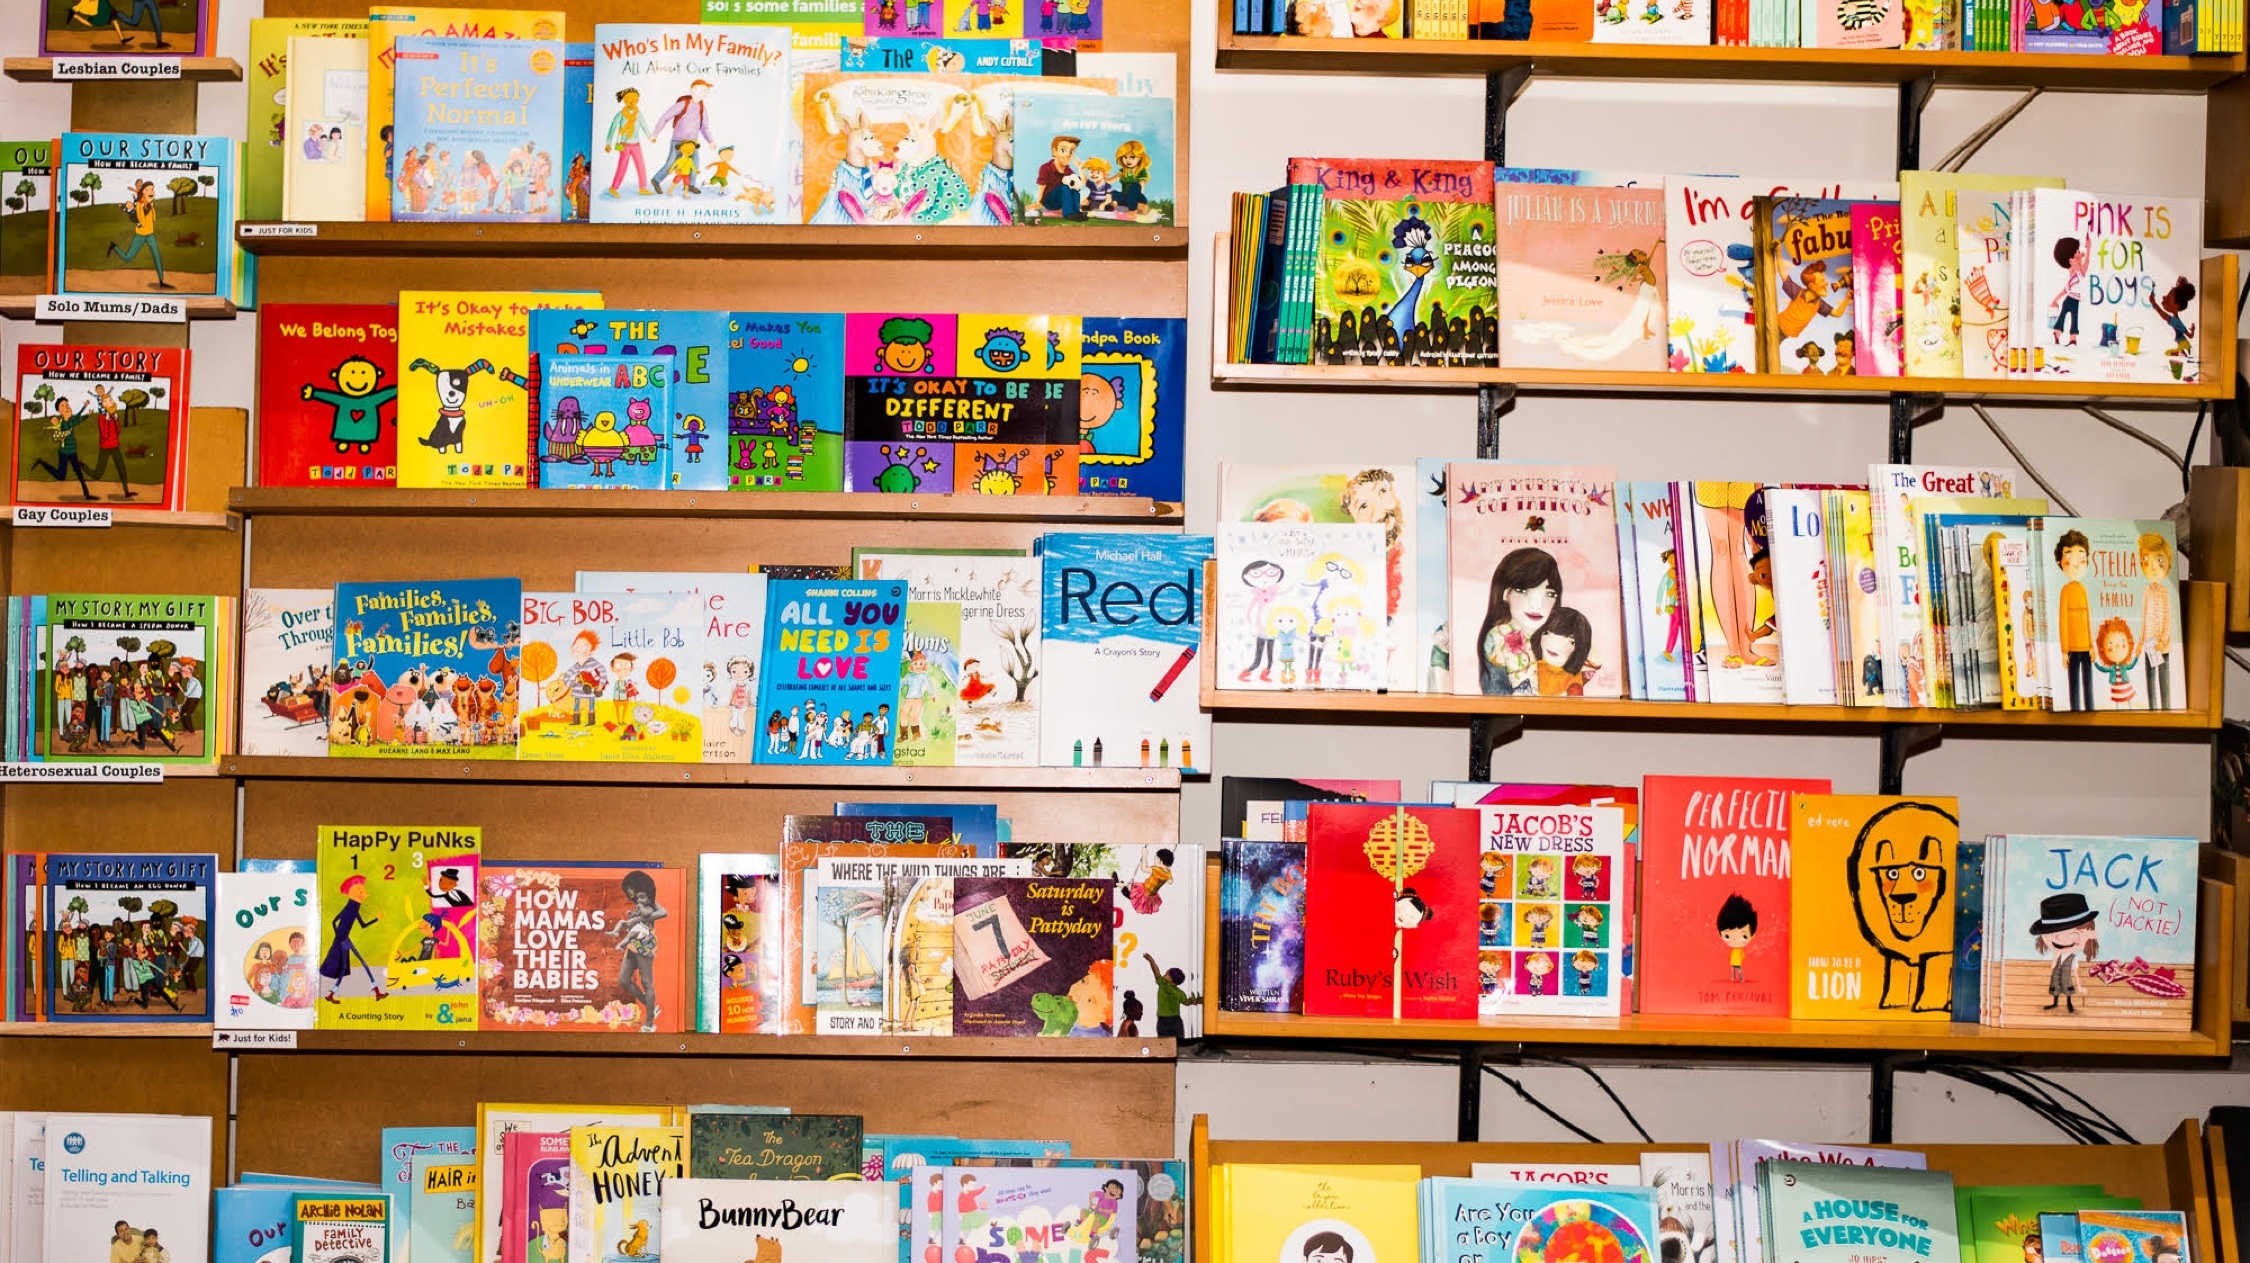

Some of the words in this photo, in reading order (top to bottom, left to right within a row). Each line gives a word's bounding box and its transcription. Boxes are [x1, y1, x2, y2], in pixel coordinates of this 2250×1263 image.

[603, 38, 658, 61] Who's
[663, 34, 680, 50] In
[686, 34, 716, 56] My
[718, 35, 782, 67] Family?
[882, 48, 914, 69] The
[58, 62, 117, 75] Lesbian
[121, 63, 180, 76] Couples
[459, 51, 497, 74] It's
[646, 60, 682, 75] About
[686, 62, 712, 75] Our
[716, 62, 762, 77] Families
[976, 56, 999, 67] ANDY
[420, 77, 538, 104] Perfectly
[426, 103, 528, 126] Normal
[80, 140, 130, 159] OUR
[142, 141, 209, 159] STORY
[1314, 167, 1376, 196] King
[1405, 169, 1473, 198] King
[694, 209, 739, 218] HARRIS
[1685, 187, 1729, 226] I'm
[257, 227, 277, 235] JUST
[278, 227, 294, 235] FOR
[296, 227, 314, 235] KIDS
[1452, 261, 1497, 274] AMONG
[47, 300, 80, 314] Solo
[84, 301, 179, 316] Mums/Dads
[414, 301, 450, 316] It's
[456, 301, 501, 319] Okay
[508, 302, 529, 316] to
[280, 323, 306, 338] We
[312, 323, 366, 342] Belong
[444, 321, 527, 337] Mistakes
[608, 321, 660, 341] THE
[745, 321, 791, 334] Makes
[796, 321, 822, 334] You
[1123, 330, 1161, 344] Book
[749, 338, 783, 350] Good
[35, 350, 84, 370] OUR
[96, 351, 162, 371] STORY
[549, 362, 597, 375] Animals
[600, 362, 611, 374] in
[549, 375, 612, 388] UNDERWEAR
[614, 363, 666, 389] ABC
[867, 378, 907, 395] IT'S
[913, 380, 967, 395] OKAY
[973, 381, 996, 396] TO
[1005, 383, 1030, 400] BE
[885, 398, 1015, 422] DIFFERENT
[952, 421, 999, 435] PARR
[1090, 477, 1128, 489] PARR
[1891, 471, 1916, 487] The
[1922, 473, 1975, 494] Great
[18, 509, 46, 523] Gay
[50, 509, 109, 522] Couples
[1096, 550, 1138, 561] Michael
[1141, 550, 1163, 561] Hall
[2091, 551, 2137, 578] STELLA
[356, 589, 446, 615] Families,
[841, 588, 878, 597] COLLINS
[908, 586, 942, 601] Morris
[944, 587, 1002, 602] Micklewhite
[1061, 567, 1196, 626] Red
[56, 600, 78, 616] MY
[81, 601, 134, 619] STORY,
[140, 601, 161, 617] MY
[166, 602, 207, 618] GIFT
[281, 609, 314, 629] Over
[400, 603, 497, 633] Families,
[523, 598, 565, 625] BIG
[573, 600, 619, 624] BOB.
[780, 601, 834, 625] ALL
[843, 601, 899, 625] YOU
[996, 606, 1025, 618] Dress
[707, 615, 751, 638] Are
[344, 629, 468, 659] Families!
[780, 629, 848, 653] NEED
[853, 629, 890, 654] IS
[1094, 648, 1101, 656] A
[1103, 648, 1138, 658] Crayon's
[1139, 648, 1161, 658] Story
[797, 656, 871, 680] LOVE
[436, 747, 451, 755] MAX
[0, 765, 98, 778] Heterosexual
[101, 765, 162, 779] Couples
[1491, 813, 1593, 837] JACOB'S
[1826, 818, 1851, 828] vere
[1491, 836, 1532, 851] NEW
[1538, 837, 1594, 853] DRESS
[350, 854, 358, 870] 1
[412, 852, 424, 868] 3
[1681, 834, 1791, 880] NORMAN
[58, 861, 80, 878] MY
[84, 861, 135, 880] STORY,
[141, 862, 163, 878] MY
[168, 863, 208, 879] GIFT
[383, 864, 396, 880] 2
[831, 862, 873, 881] WHERE
[2045, 848, 2164, 893] JACK
[515, 890, 578, 910] HOW
[1026, 882, 1105, 903] Saturday
[235, 896, 280, 929] Our
[1061, 900, 1074, 916] is
[515, 911, 605, 930] MAMAS
[1028, 918, 1102, 938] Pattyday
[514, 931, 578, 950] LOVE
[513, 950, 587, 969] THEIR
[513, 970, 600, 990] BABIES
[1325, 968, 1392, 993] Ruby's
[1403, 972, 1457, 991] Wish
[1807, 971, 1862, 1001] LION
[450, 1001, 469, 1010] john
[338, 1012, 345, 1021] A
[346, 1012, 382, 1023] Counting
[384, 1013, 405, 1023] Story
[454, 1015, 473, 1024] jana
[829, 1016, 855, 1030] STORY
[857, 1017, 876, 1030] AND
[233, 1033, 251, 1043] Just
[253, 1033, 267, 1043] for
[269, 1033, 291, 1043] Kids!
[437, 1142, 460, 1153] THE
[540, 1136, 569, 1147] SOME
[763, 1131, 783, 1145] The
[725, 1147, 754, 1166] Tea
[755, 1146, 822, 1173] Dragon
[62, 1169, 108, 1185] Telling
[111, 1171, 138, 1184] and
[141, 1171, 190, 1188] Talking
[1671, 1182, 1705, 1197] Morris
[698, 1197, 846, 1230] BunnyBear
[1456, 1203, 1490, 1222] Are
[1685, 1202, 1698, 1211] and
[1698, 1202, 1711, 1211] the
[1802, 1211, 1813, 1222] A
[1811, 1200, 1899, 1222] HOUSE
[1901, 1213, 1929, 1232] FOR
[249, 1221, 287, 1248] Our
[1456, 1232, 1469, 1245] a
[1473, 1227, 1512, 1250] Boy
[1800, 1226, 1933, 1258] EVERYONE
